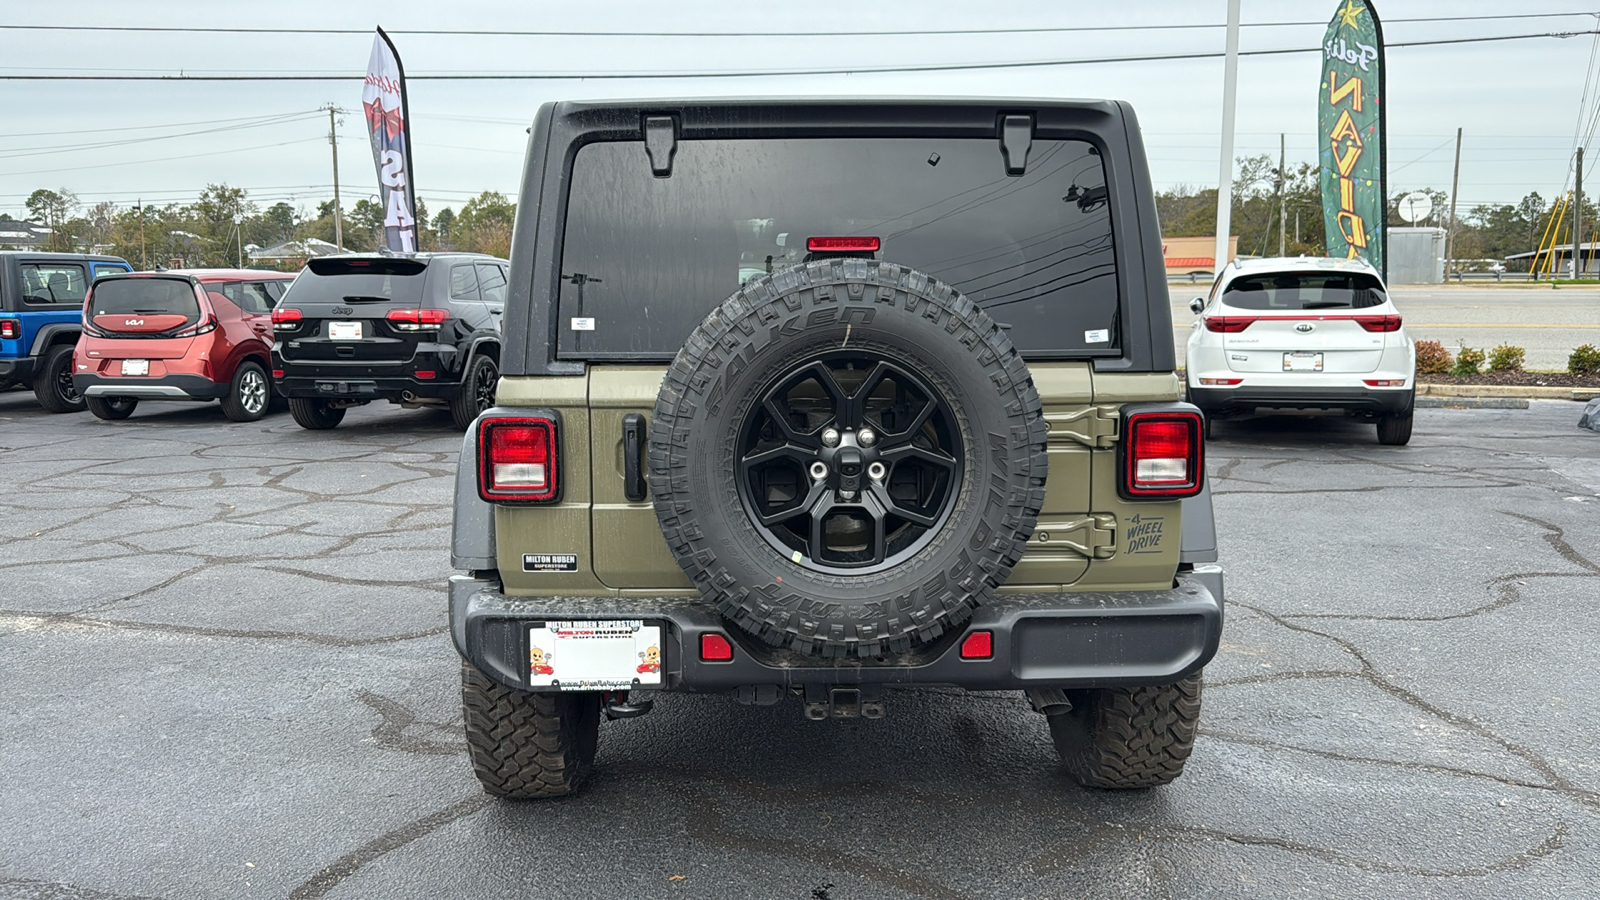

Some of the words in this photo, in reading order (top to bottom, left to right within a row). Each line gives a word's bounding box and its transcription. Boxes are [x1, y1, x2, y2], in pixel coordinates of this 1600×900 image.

[332, 306, 353, 315] Jeep
[705, 306, 877, 420] FALKEN
[859, 432, 1009, 620] WILDPEAK
[1131, 513, 1140, 525] 4
[1127, 522, 1163, 540] WHEEL
[1127, 535, 1162, 554] DRIVE
[525, 555, 551, 563] MILTON
[552, 555, 575, 563] RUBEN
[545, 621, 572, 629] MILTON
[573, 620, 597, 629] RUBEN
[598, 620, 643, 628] SUPERSTORE
